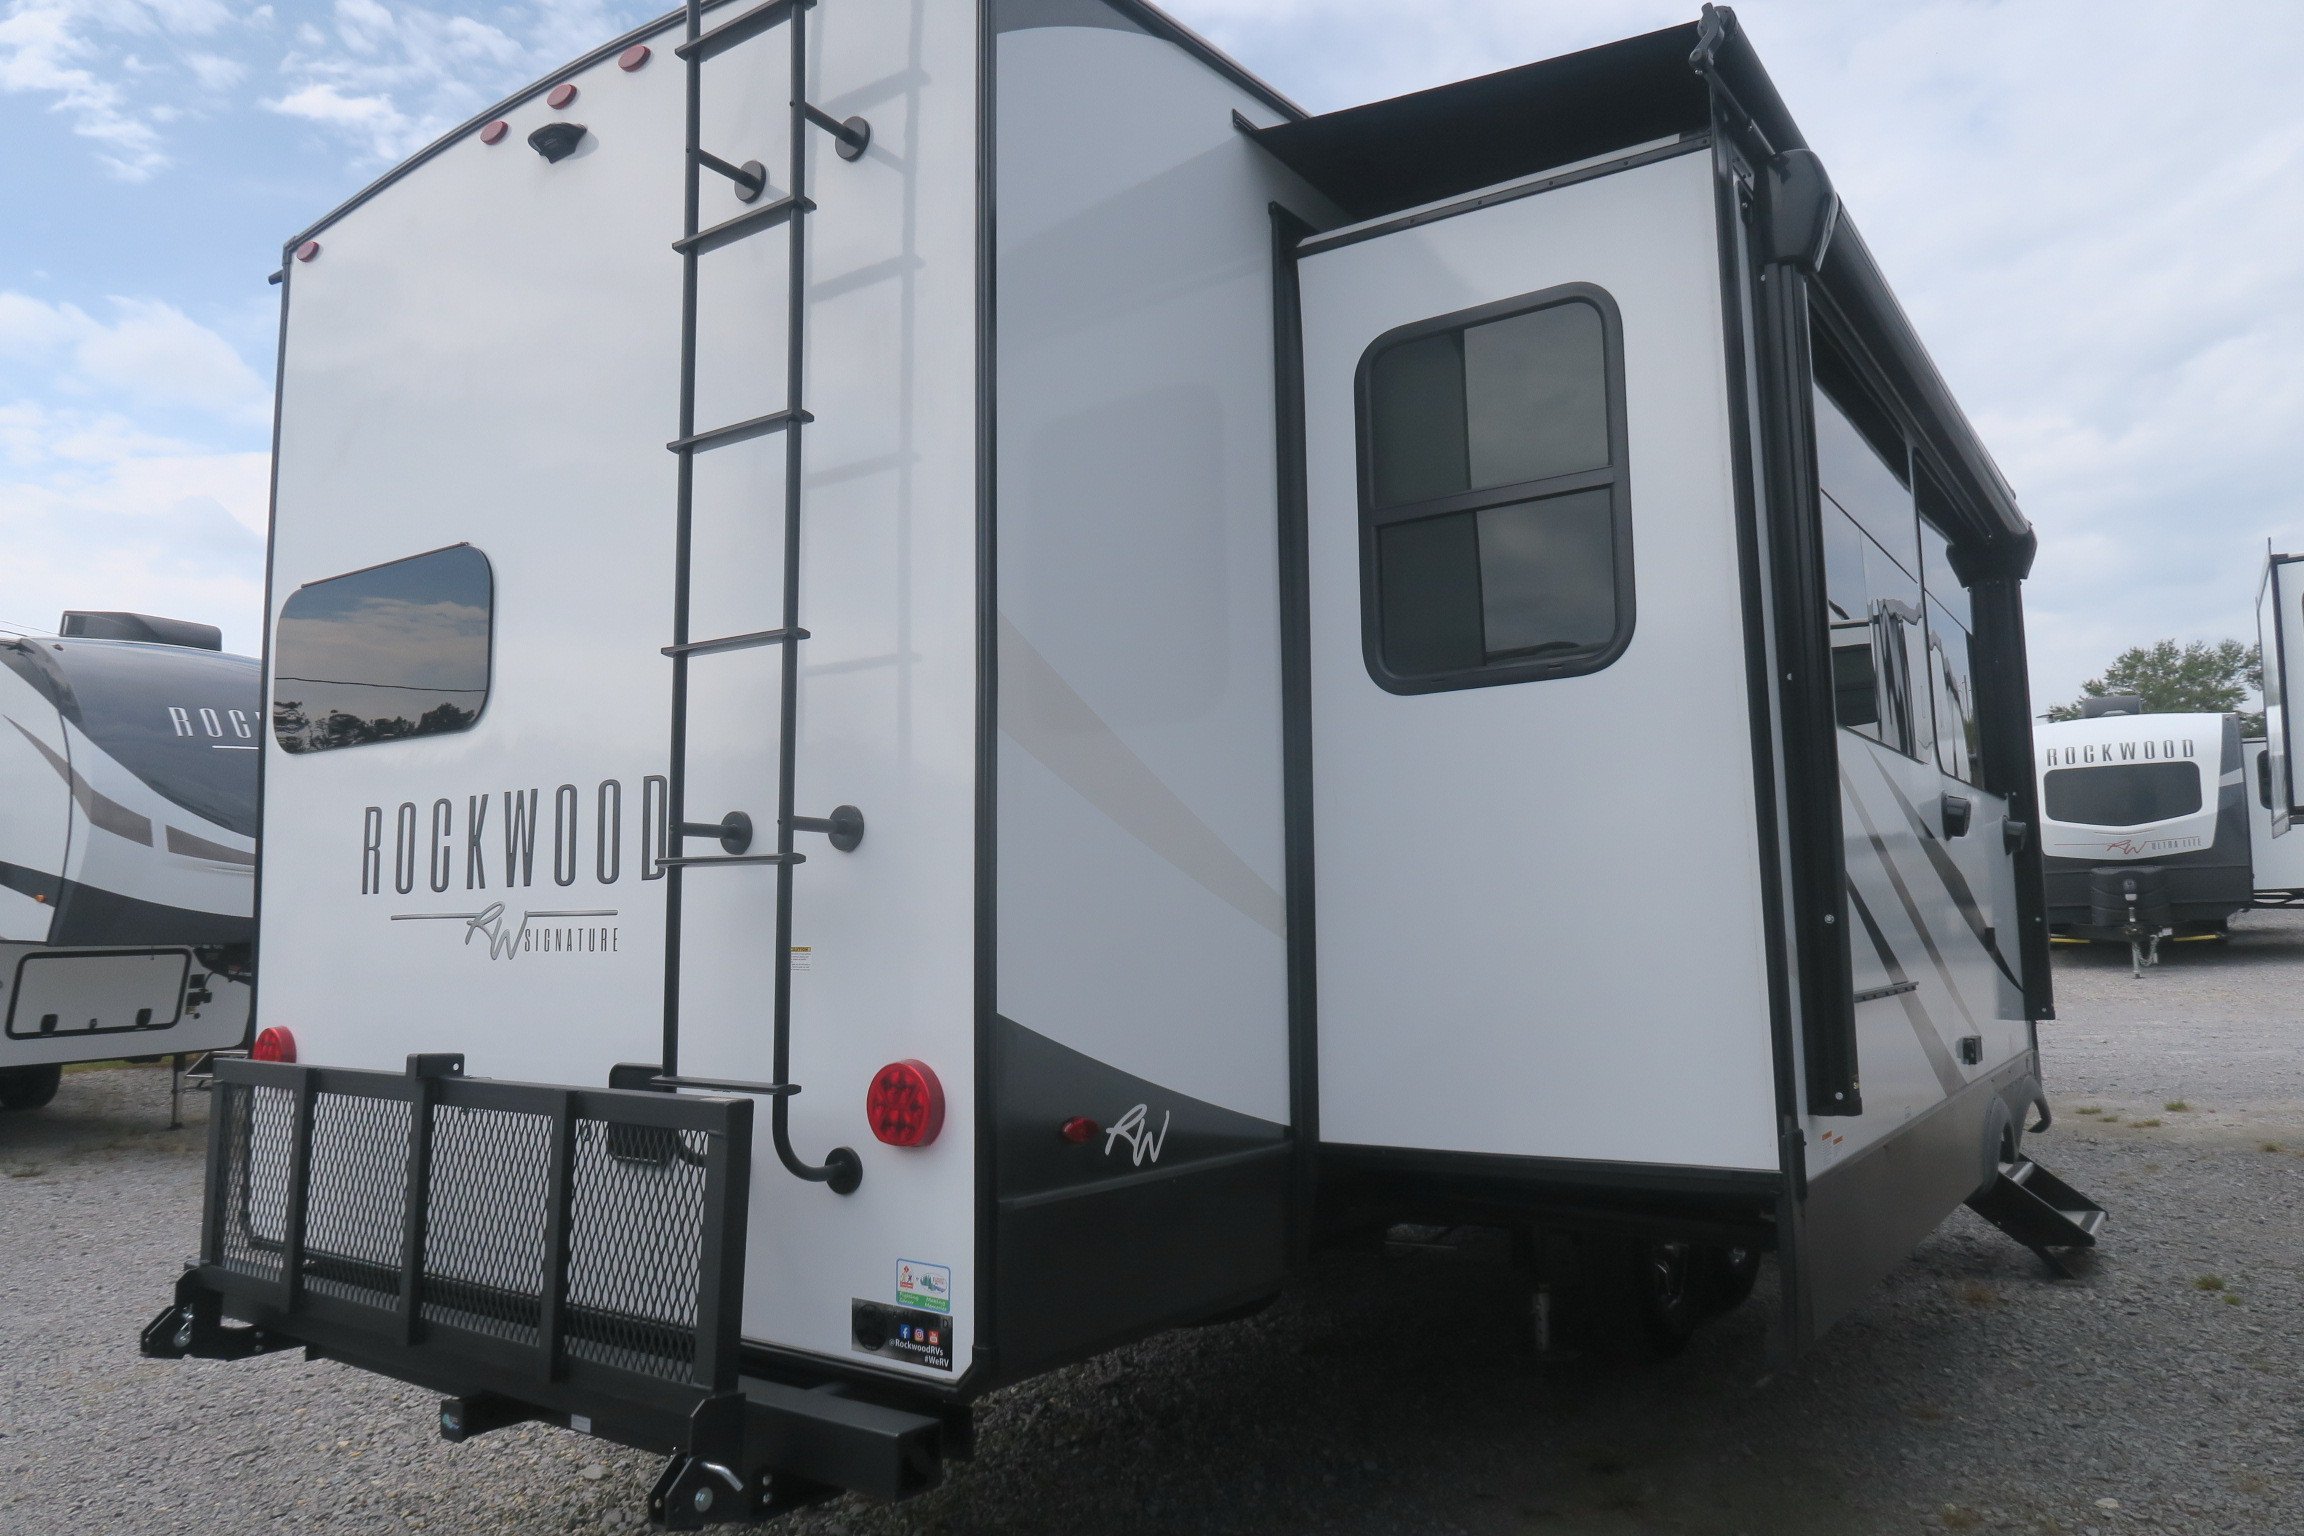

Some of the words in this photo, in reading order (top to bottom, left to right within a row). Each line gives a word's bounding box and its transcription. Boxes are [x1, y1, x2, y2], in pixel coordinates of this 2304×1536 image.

[168, 706, 260, 738] ROC
[2046, 739, 2195, 767] ROCKWOOD
[361, 774, 668, 895] ROCKWOOD
[524, 927, 619, 952] SIGNATURE
[1104, 1103, 1170, 1167] RW
[889, 1339, 943, 1355] @RockwoodRVs
[925, 1357, 949, 1367] #WeRV
